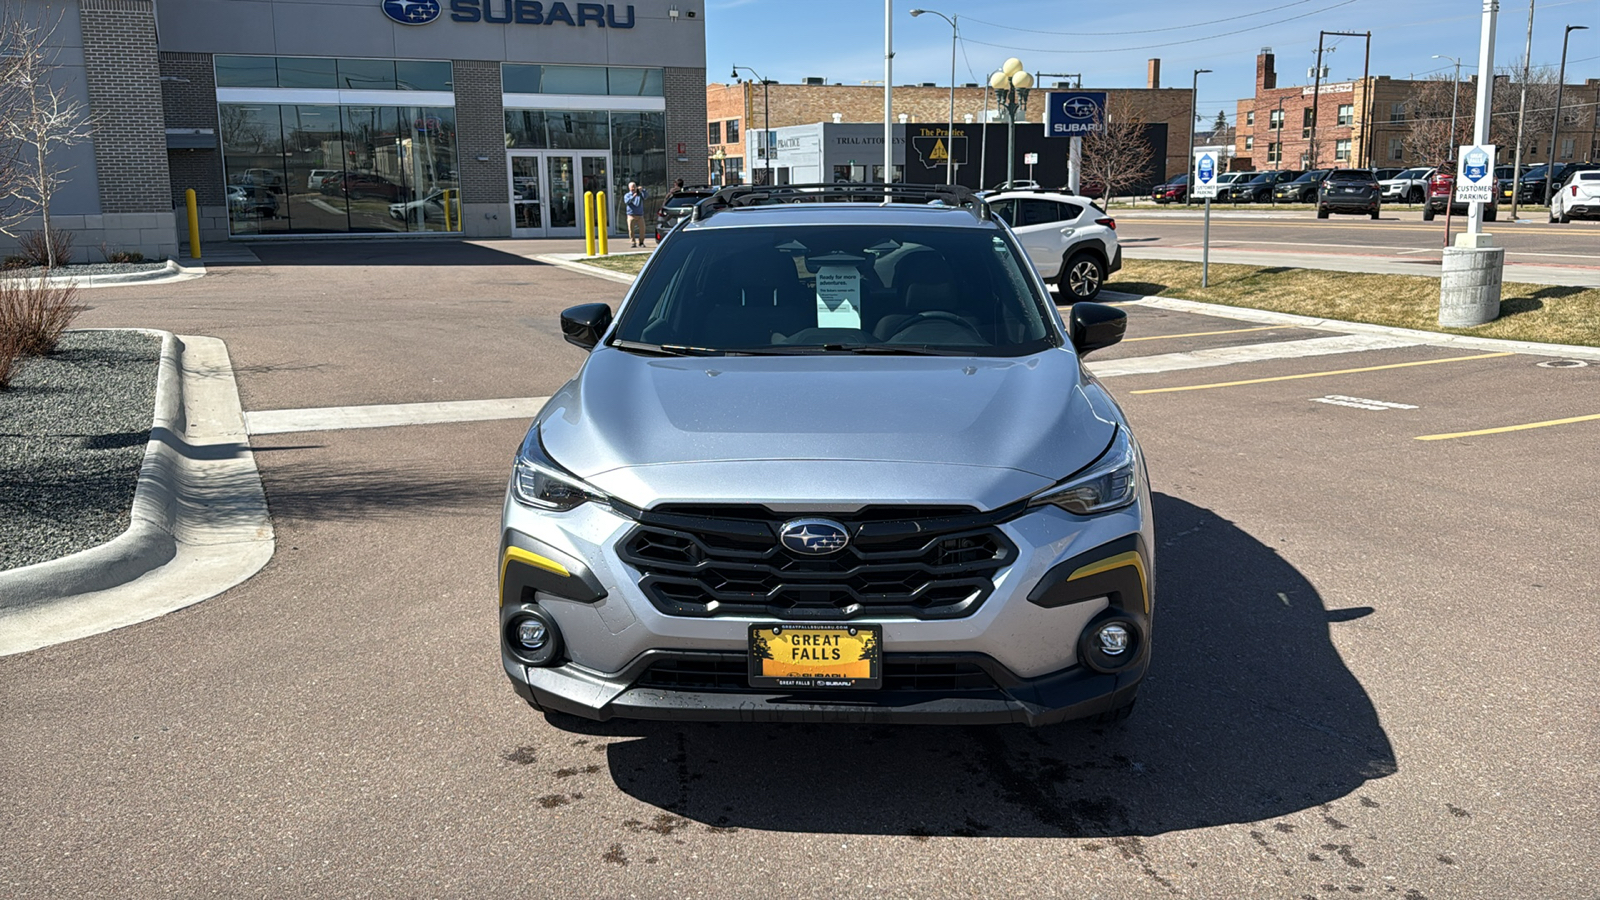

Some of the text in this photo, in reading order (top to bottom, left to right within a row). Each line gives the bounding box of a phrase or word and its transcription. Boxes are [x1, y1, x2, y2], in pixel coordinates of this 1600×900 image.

[451, 0, 635, 28] SUBARU
[920, 128, 965, 136] The Pratice
[1054, 123, 1103, 132] SUBARU
[778, 138, 800, 148] PRACTICE
[837, 137, 860, 145] TRIAL
[791, 634, 841, 646] GREAT
[791, 648, 841, 660] FALLS
